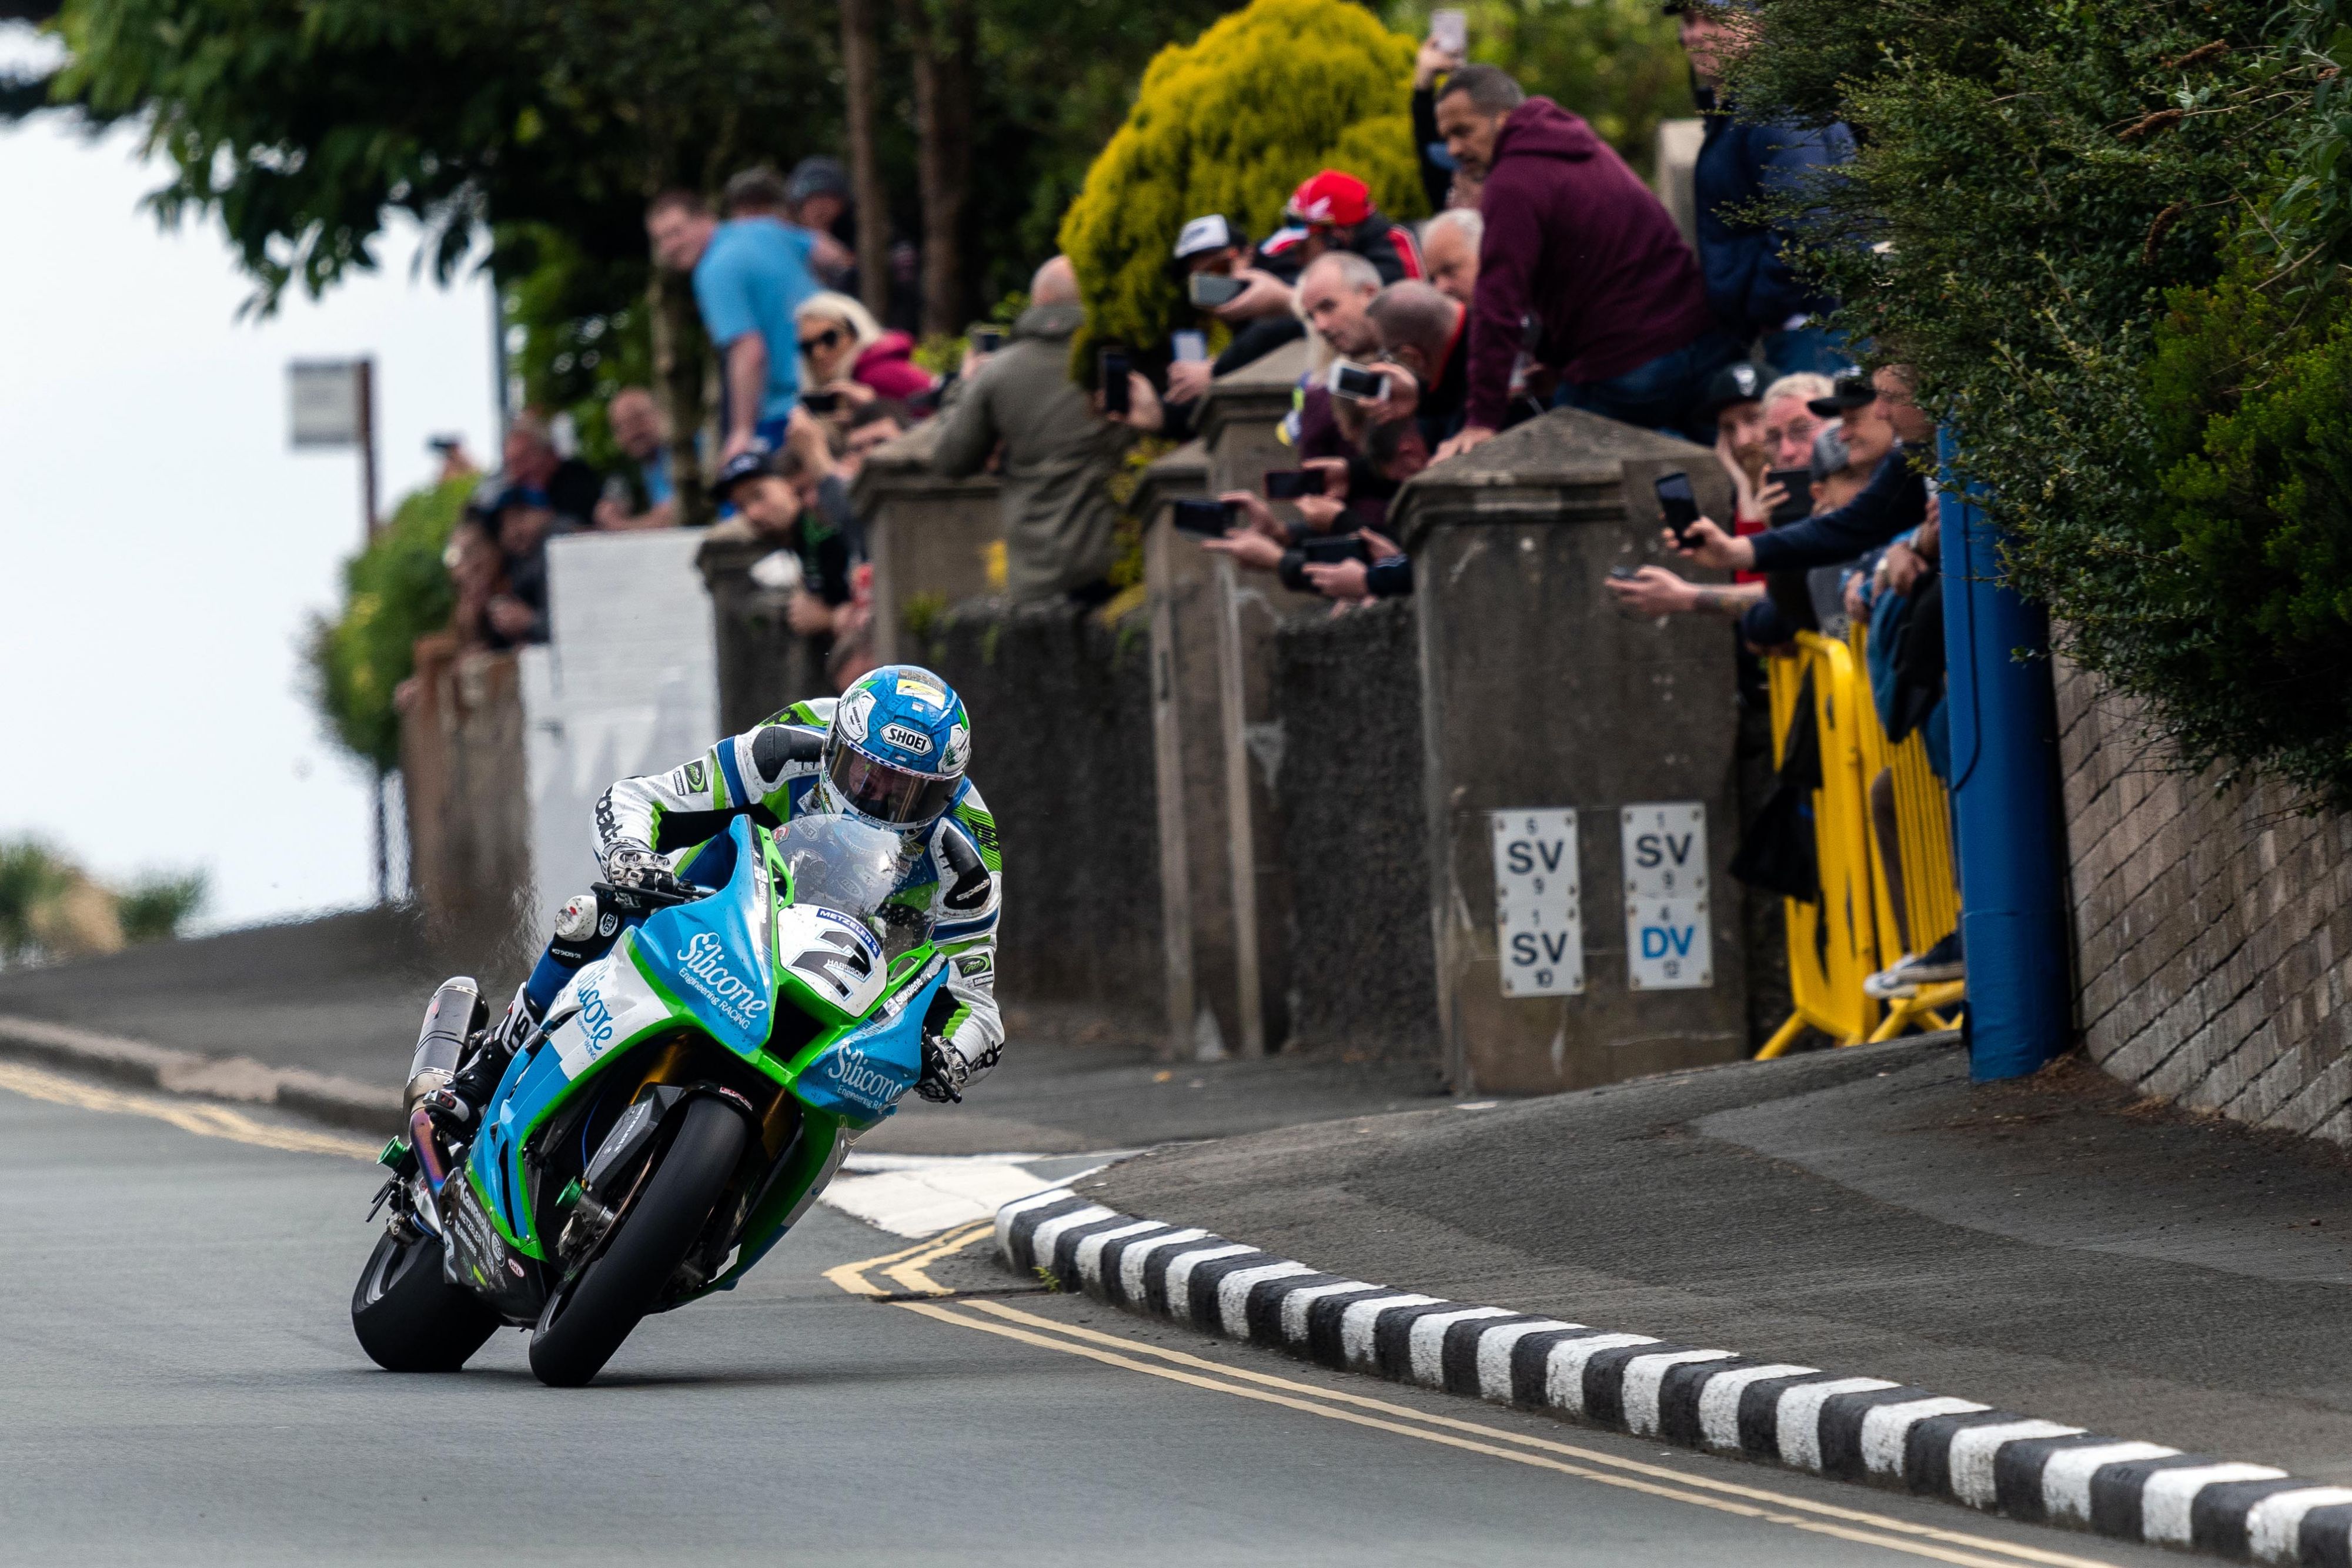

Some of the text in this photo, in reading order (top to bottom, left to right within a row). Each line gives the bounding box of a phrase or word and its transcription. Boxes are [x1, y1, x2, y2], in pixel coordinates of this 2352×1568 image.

[849, 742, 897, 769] PRO
[888, 728, 927, 751] SHOEI
[687, 765, 699, 783] Green
[1507, 839, 1563, 875] SV
[1635, 832, 1692, 868] SV
[820, 910, 871, 944] METZELER
[1641, 925, 1694, 959] DV
[790, 930, 873, 999] 2
[1511, 931, 1568, 967] SV
[677, 932, 767, 1018] Silicone
[963, 961, 984, 974] Green
[679, 967, 750, 1029] Engineering RACING
[896, 978, 924, 1005] Silkolene
[837, 1084, 873, 1109] Engineering
[458, 1207, 482, 1246] METZELER
[460, 1179, 491, 1246] Kawasaki
